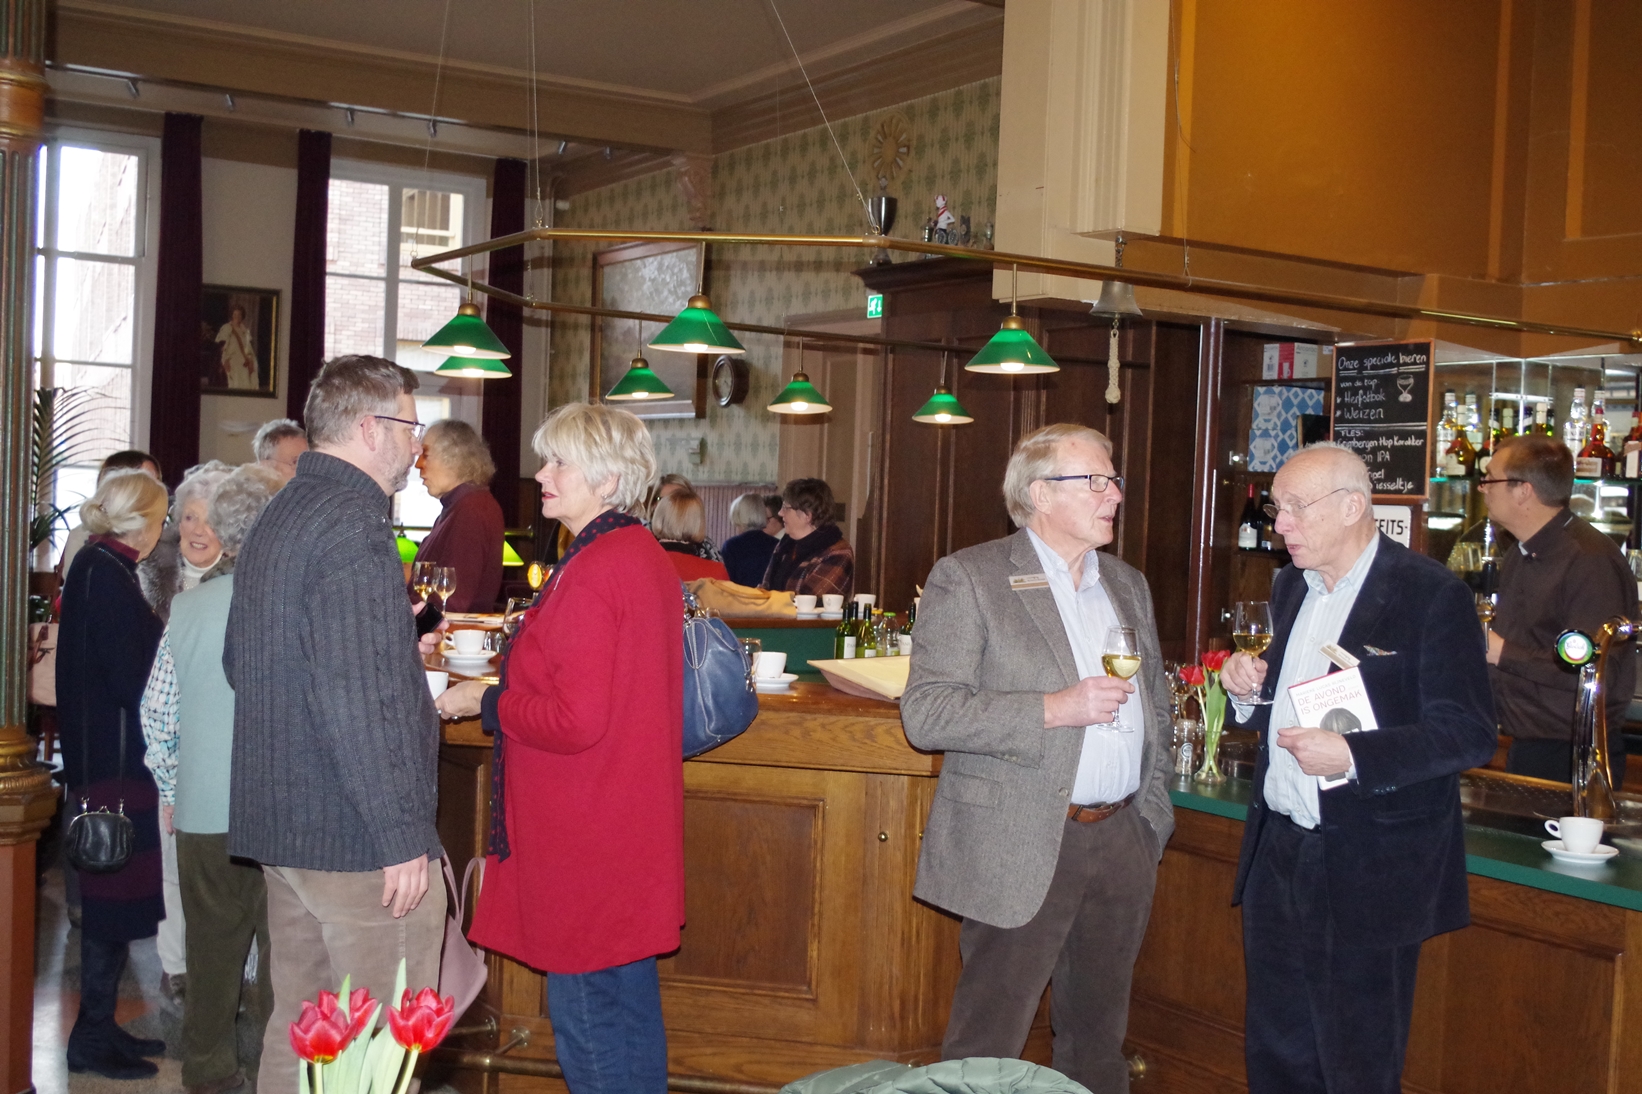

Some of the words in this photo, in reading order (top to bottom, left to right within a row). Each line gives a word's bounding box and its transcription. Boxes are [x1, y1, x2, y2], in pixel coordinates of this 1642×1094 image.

[1338, 356, 1359, 369] Onze
[1363, 352, 1397, 370] speciale
[1399, 352, 1427, 364] bieren
[1344, 389, 1385, 407] Herfstbok
[1344, 407, 1384, 420] Weizen
[1340, 429, 1364, 437] FLES:
[1379, 435, 1393, 449] Hop
[1393, 435, 1424, 446] Karakter
[1377, 451, 1390, 463] IPA
[1316, 683, 1331, 691] LUCAS
[1297, 695, 1312, 706] DE
[1314, 684, 1346, 701] AVOND
[1300, 706, 1311, 715] IS
[1313, 690, 1362, 711] ONGEMAK
